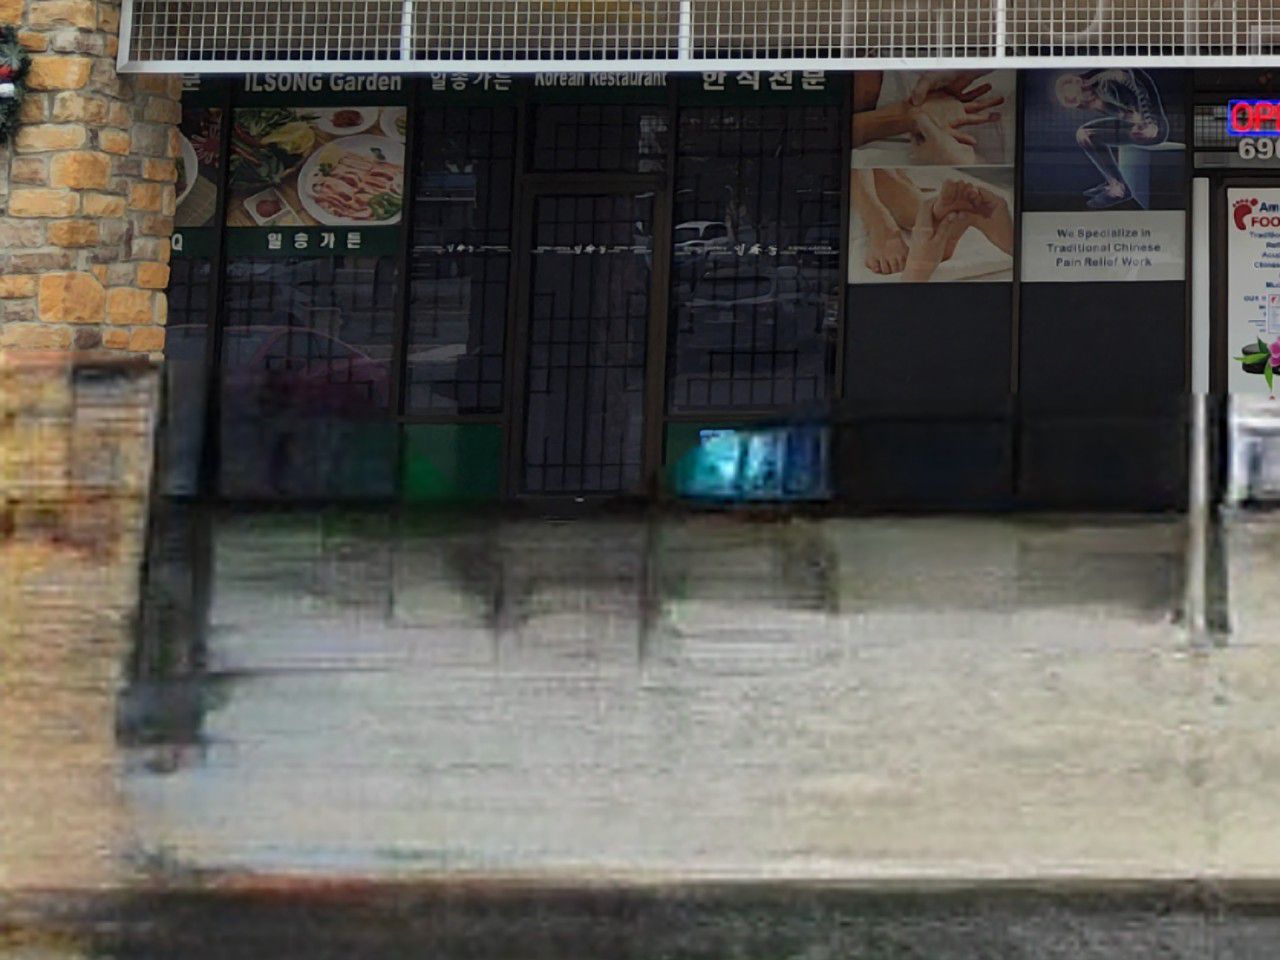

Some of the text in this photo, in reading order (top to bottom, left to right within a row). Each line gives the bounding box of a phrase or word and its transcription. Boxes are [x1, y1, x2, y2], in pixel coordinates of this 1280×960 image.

[244, 72, 402, 91] ILSONG Garden
[535, 72, 668, 87] Korean Restaurant
[1046, 243, 1161, 253] Traditional Chinese
[1056, 257, 1152, 267] Pain Relief Work
